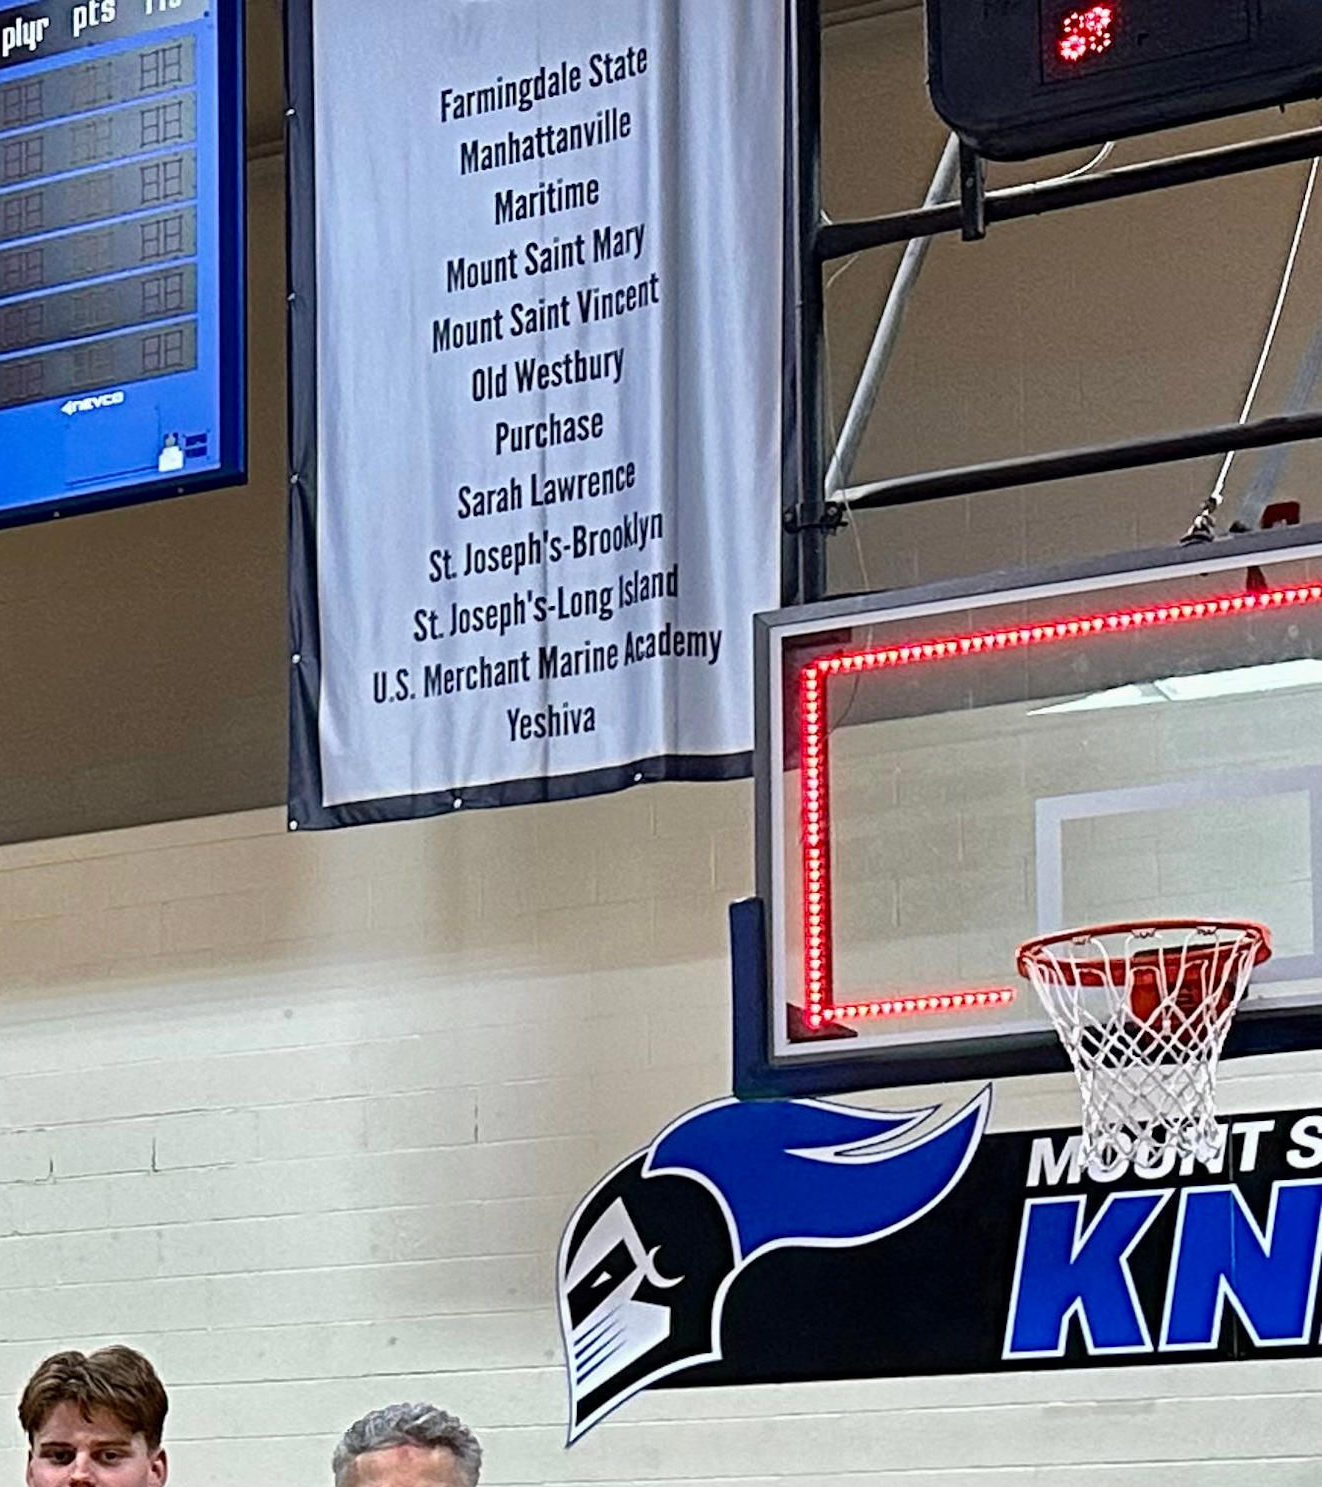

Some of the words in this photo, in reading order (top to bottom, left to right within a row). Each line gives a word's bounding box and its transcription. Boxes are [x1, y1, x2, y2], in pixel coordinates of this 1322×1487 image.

[2, 17, 50, 57] plyr
[73, 0, 115, 37] pts
[440, 61, 582, 124] Farmingdale
[589, 45, 648, 88] State
[460, 108, 632, 176] Manhattanville
[495, 177, 600, 226] Maritime
[446, 248, 518, 294] Mount
[524, 234, 585, 277] Saint
[593, 223, 646, 264] Mary
[432, 308, 504, 354] Mount
[510, 295, 571, 338] Saint
[577, 273, 660, 325] Vincent
[471, 365, 508, 402] Old
[514, 347, 625, 395] Westbury
[496, 411, 604, 456] Purchase
[457, 479, 524, 520] Sarah
[530, 461, 636, 508] Lawrence
[429, 547, 458, 584] St.
[463, 510, 664, 578] Joseph's-Brooklyn
[413, 606, 444, 643] St.
[449, 584, 614, 638] Joseph's-Long
[618, 564, 680, 609] Island
[372, 667, 416, 704] U.S.
[424, 650, 531, 698] Merchant
[538, 637, 618, 681] Marine
[624, 623, 723, 666] Academy
[506, 701, 596, 743] Yeshiva
